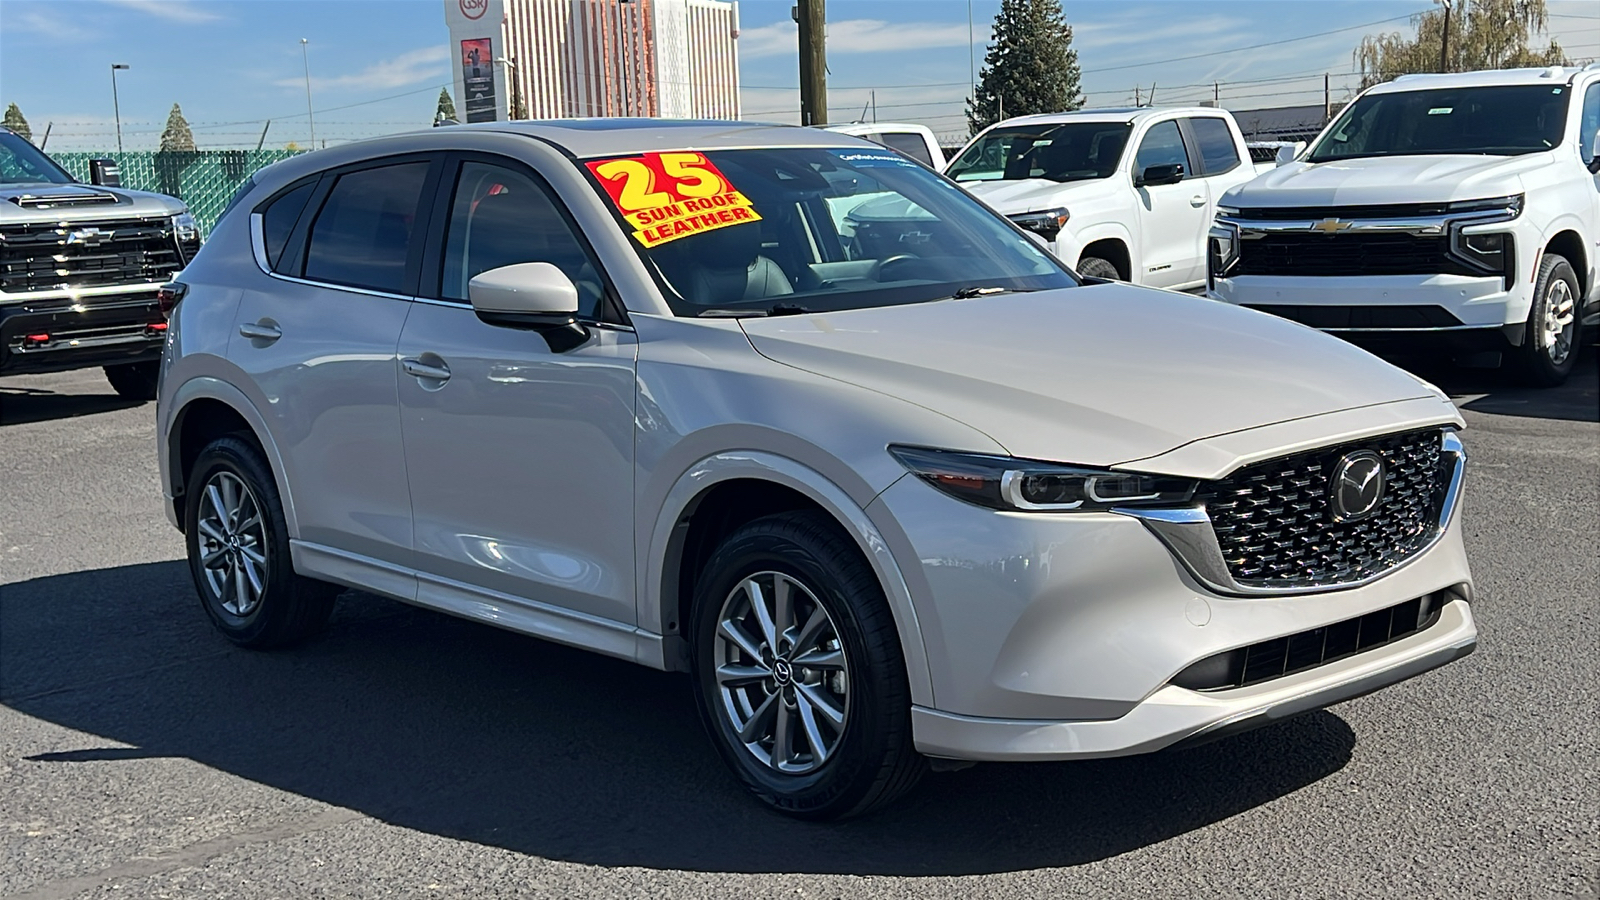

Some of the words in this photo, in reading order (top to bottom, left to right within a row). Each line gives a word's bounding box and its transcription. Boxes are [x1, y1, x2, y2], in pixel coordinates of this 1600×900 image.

[463, 0, 484, 9] GSR
[596, 153, 727, 211] 25
[636, 203, 684, 225] SUN
[685, 193, 739, 213] ROOF
[643, 207, 752, 243] LEATHER
